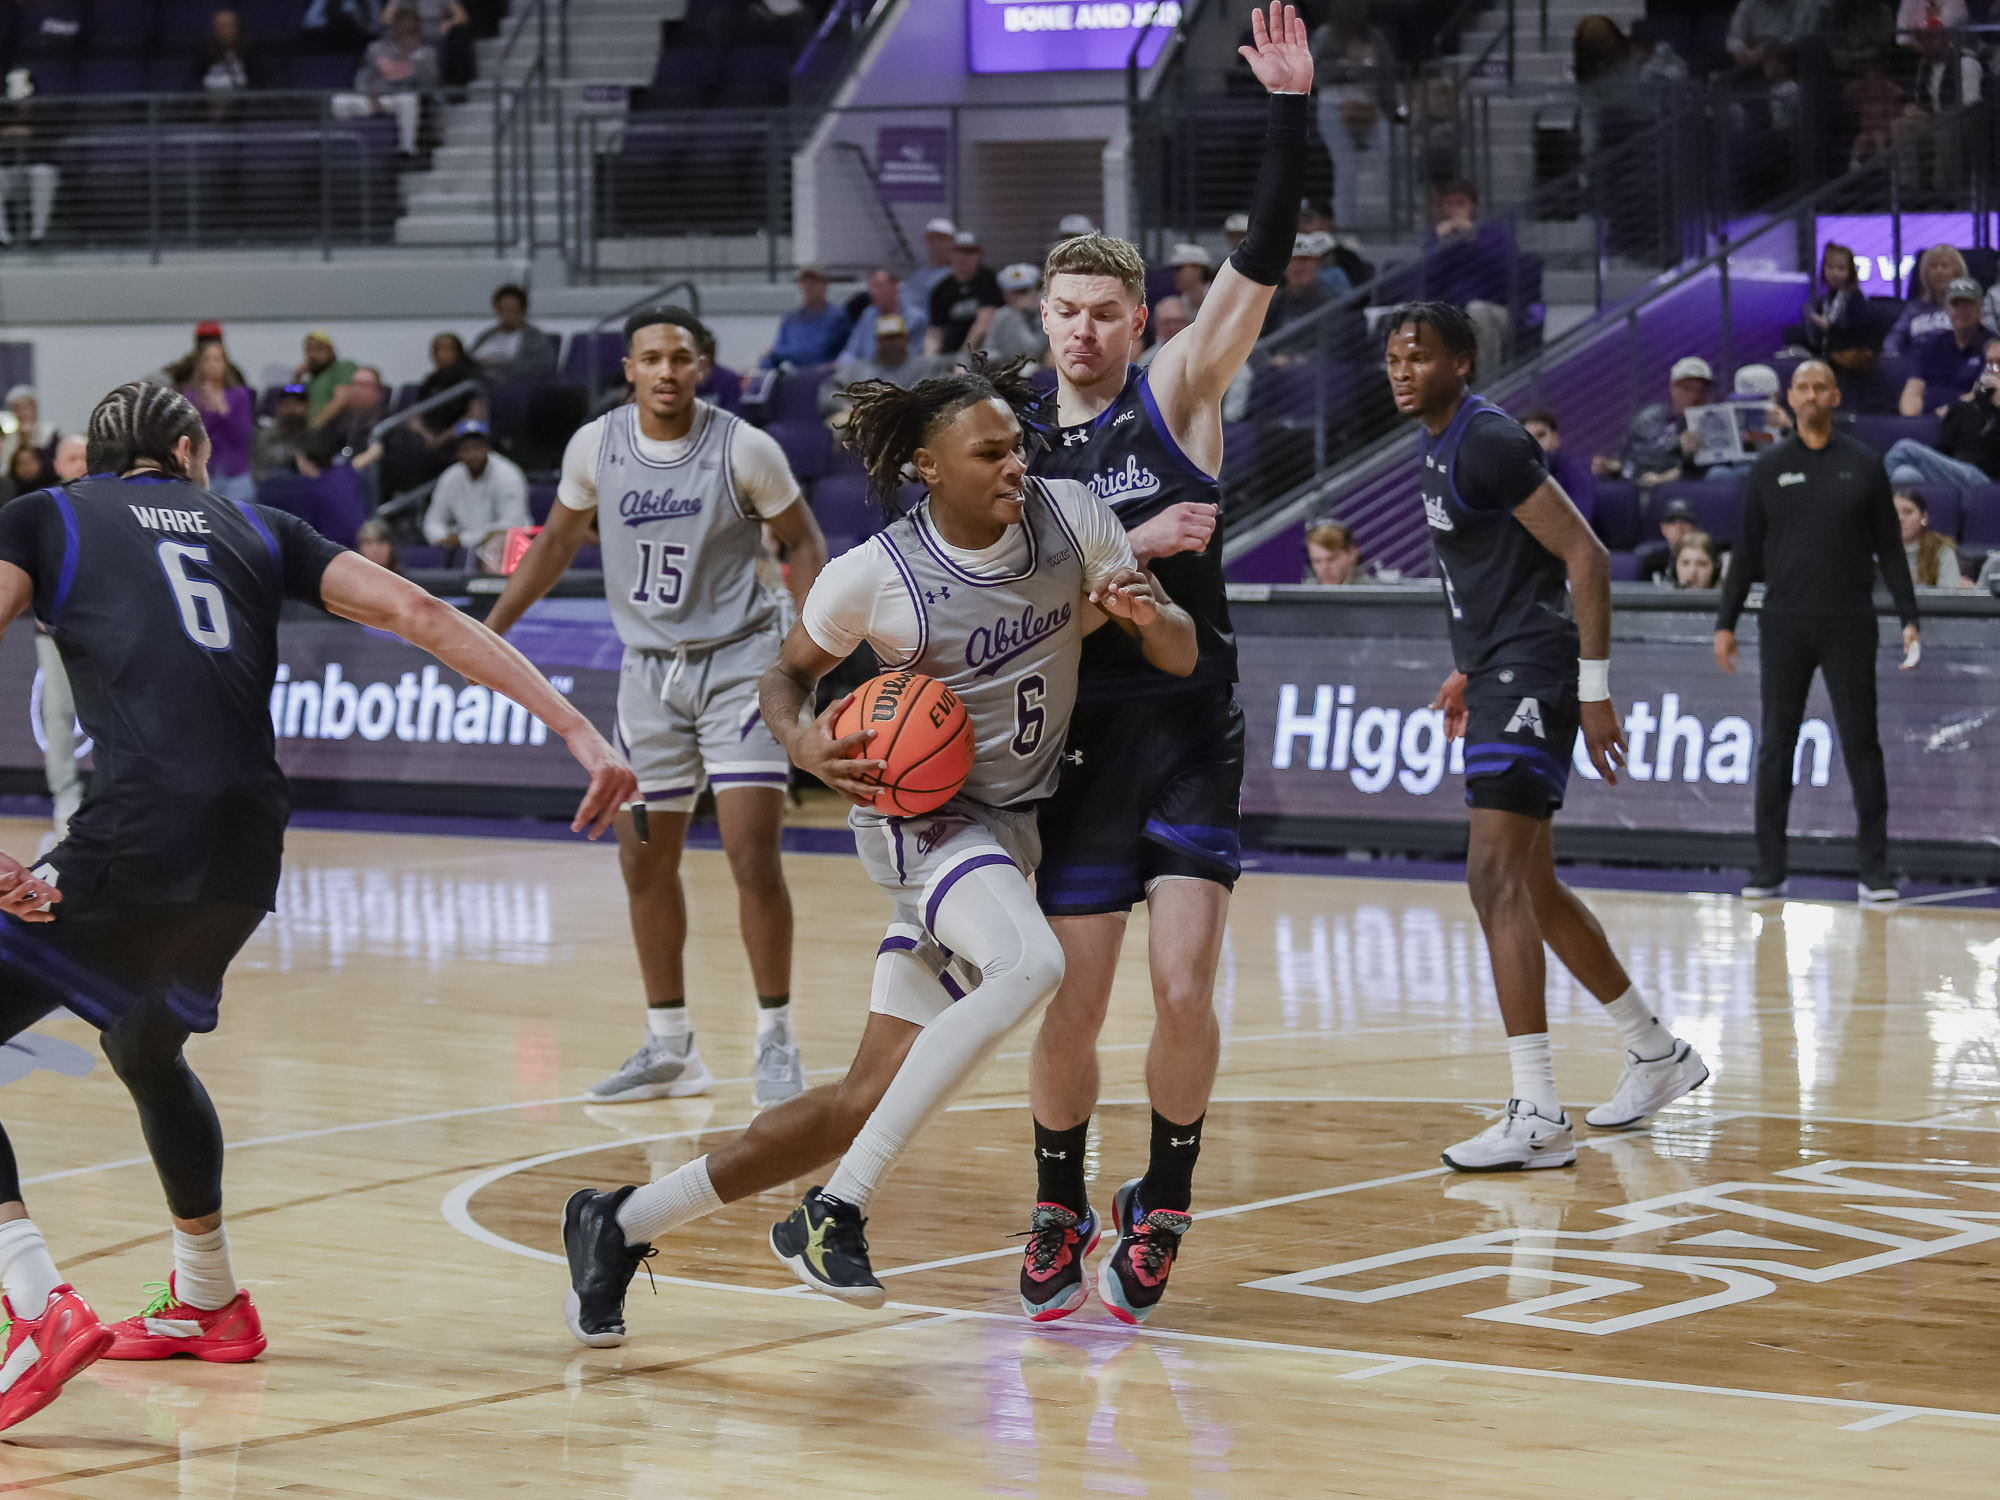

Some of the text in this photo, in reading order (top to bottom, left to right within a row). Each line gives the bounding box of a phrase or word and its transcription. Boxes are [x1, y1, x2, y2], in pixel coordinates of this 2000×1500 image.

[1004, 5, 1074, 32] BONE
[1074, 3, 1132, 30] AND
[1112, 410, 1135, 427] WAC
[1086, 454, 1160, 498] ericks
[128, 504, 212, 534] WARE
[619, 487, 702, 526] Abilene
[629, 539, 688, 608] 15
[1047, 549, 1071, 568] WAC
[155, 538, 232, 652] 6
[965, 602, 1071, 672] Abilene
[270, 662, 548, 746] inbotham
[1009, 671, 1047, 760] 6
